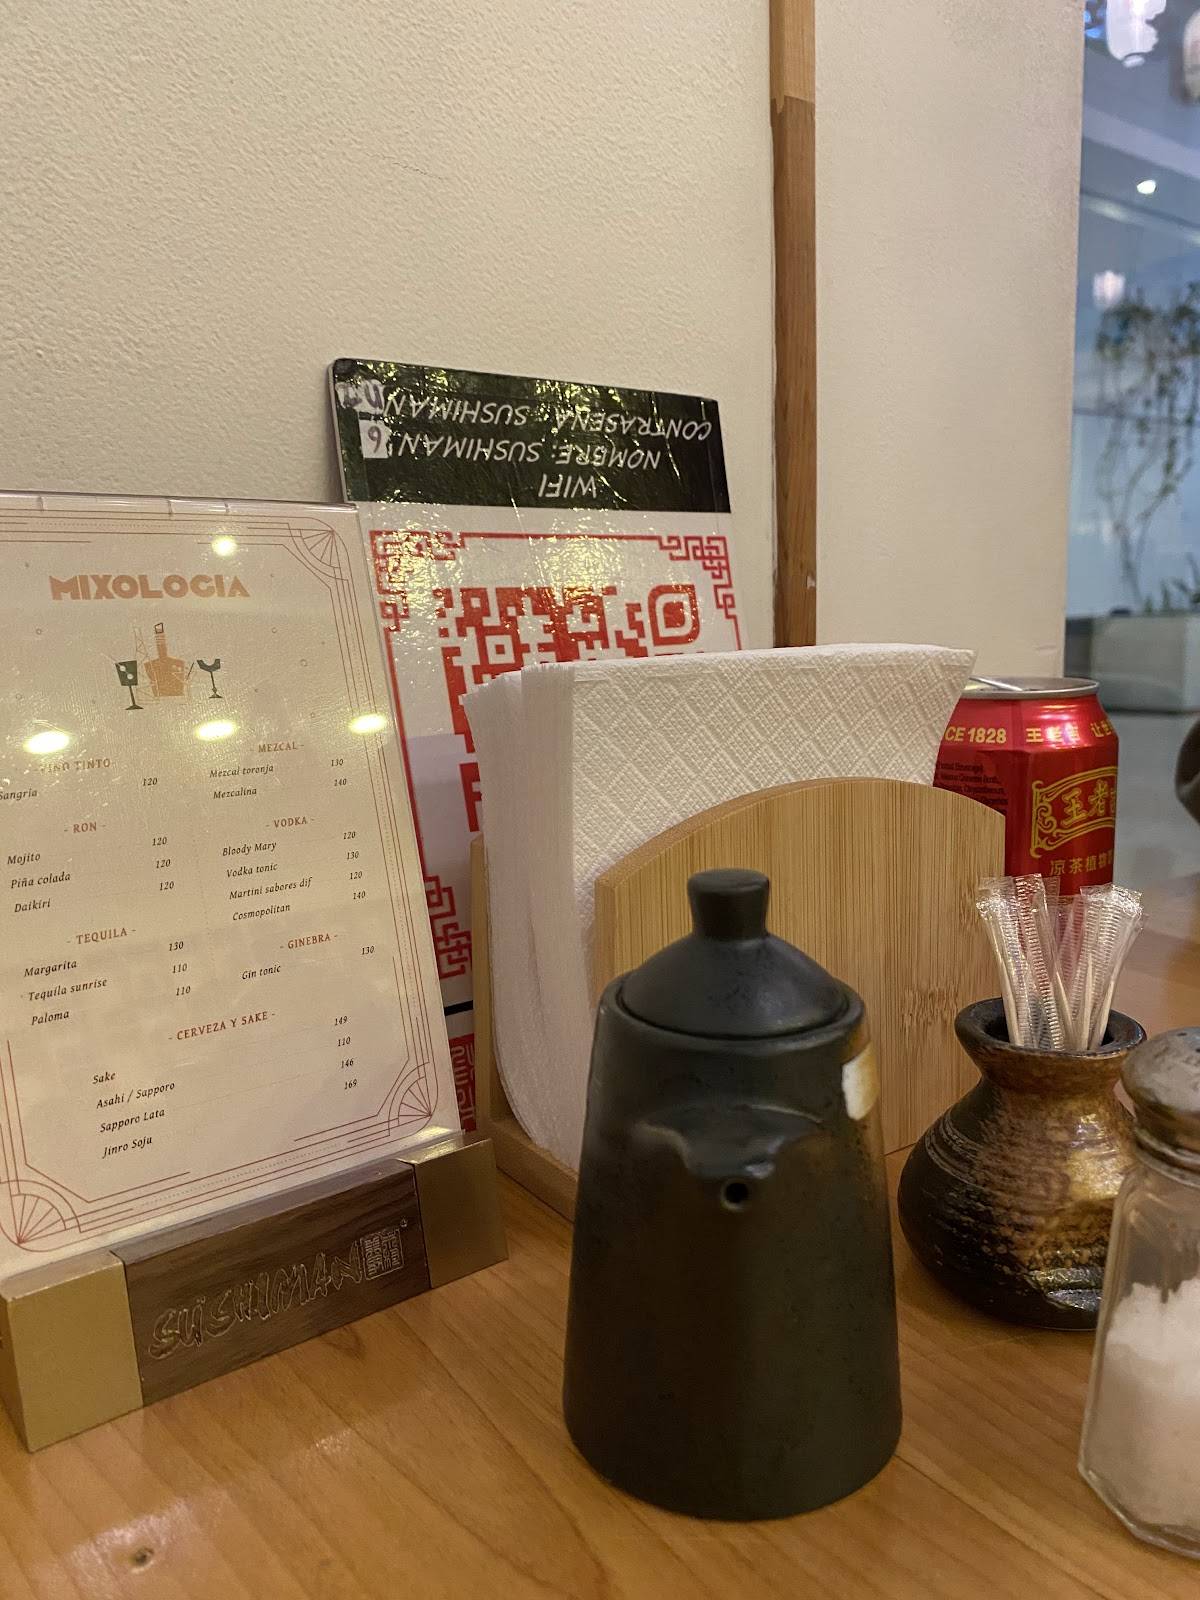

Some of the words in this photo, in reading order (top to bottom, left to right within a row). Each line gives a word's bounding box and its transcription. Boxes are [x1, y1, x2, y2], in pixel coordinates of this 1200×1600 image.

[383, 394, 530, 427] SUSHIMAN
[551, 443, 661, 471] NOMBRE:
[539, 473, 597, 499] WIFI
[49, 574, 250, 600] MIXOLOGIA
[258, 741, 298, 753] MEZCAL
[967, 727, 1007, 744] 1828
[75, 759, 111, 771] TINTO
[209, 765, 240, 779] Mezcal
[242, 762, 274, 775] toronja
[331, 758, 344, 767] 130
[142, 777, 158, 787] 120
[213, 785, 257, 800] Mezcalina
[334, 778, 347, 787] 140
[73, 822, 98, 834] RON
[273, 816, 308, 829] VODKA
[7, 853, 41, 866] Mojito
[152, 836, 168, 847] 120
[222, 844, 252, 857] Bloody
[254, 840, 277, 853] Mary
[343, 831, 356, 840] 120
[10, 875, 34, 889] Piña
[37, 871, 71, 886] colada
[156, 859, 171, 869] 120
[226, 866, 253, 878] Vodka
[256, 862, 278, 873] tonic
[346, 851, 359, 860] 130
[14, 898, 51, 913] Daikiri
[159, 881, 175, 891] 120
[229, 885, 263, 900] Martini
[265, 880, 297, 894] sabores
[299, 877, 313, 889] dif
[349, 871, 363, 880] 120
[232, 904, 291, 921] Cosmopolitan
[352, 891, 366, 900] 140
[76, 927, 127, 945] TEQUILA
[287, 933, 331, 949] GINEBRA
[24, 959, 77, 978] Margarita
[168, 941, 184, 952] 130
[242, 969, 257, 980] Gin
[259, 964, 281, 977] tonic
[361, 945, 375, 956] 130
[28, 984, 67, 1002] Tequila
[70, 977, 108, 993] sunrise
[172, 963, 188, 974] 110
[31, 1010, 70, 1026] Paloma
[176, 985, 191, 996] 110
[177, 1020, 226, 1041] CERVEZA
[230, 1018, 237, 1028] Y
[241, 1011, 269, 1026] SAKE
[92, 1070, 116, 1085] Sake
[334, 1015, 348, 1026] 149
[96, 1090, 125, 1110] Asahi
[136, 1081, 175, 1099] Sapporo
[337, 1036, 351, 1047] 110
[99, 1114, 140, 1133] Sapporo
[143, 1108, 165, 1122] Lata
[340, 1057, 354, 1069] 146
[102, 1143, 128, 1159] Jinro
[132, 1134, 153, 1149] Soju
[344, 1078, 358, 1090] 169
[148, 1241, 363, 1359] SUSHIMAN
